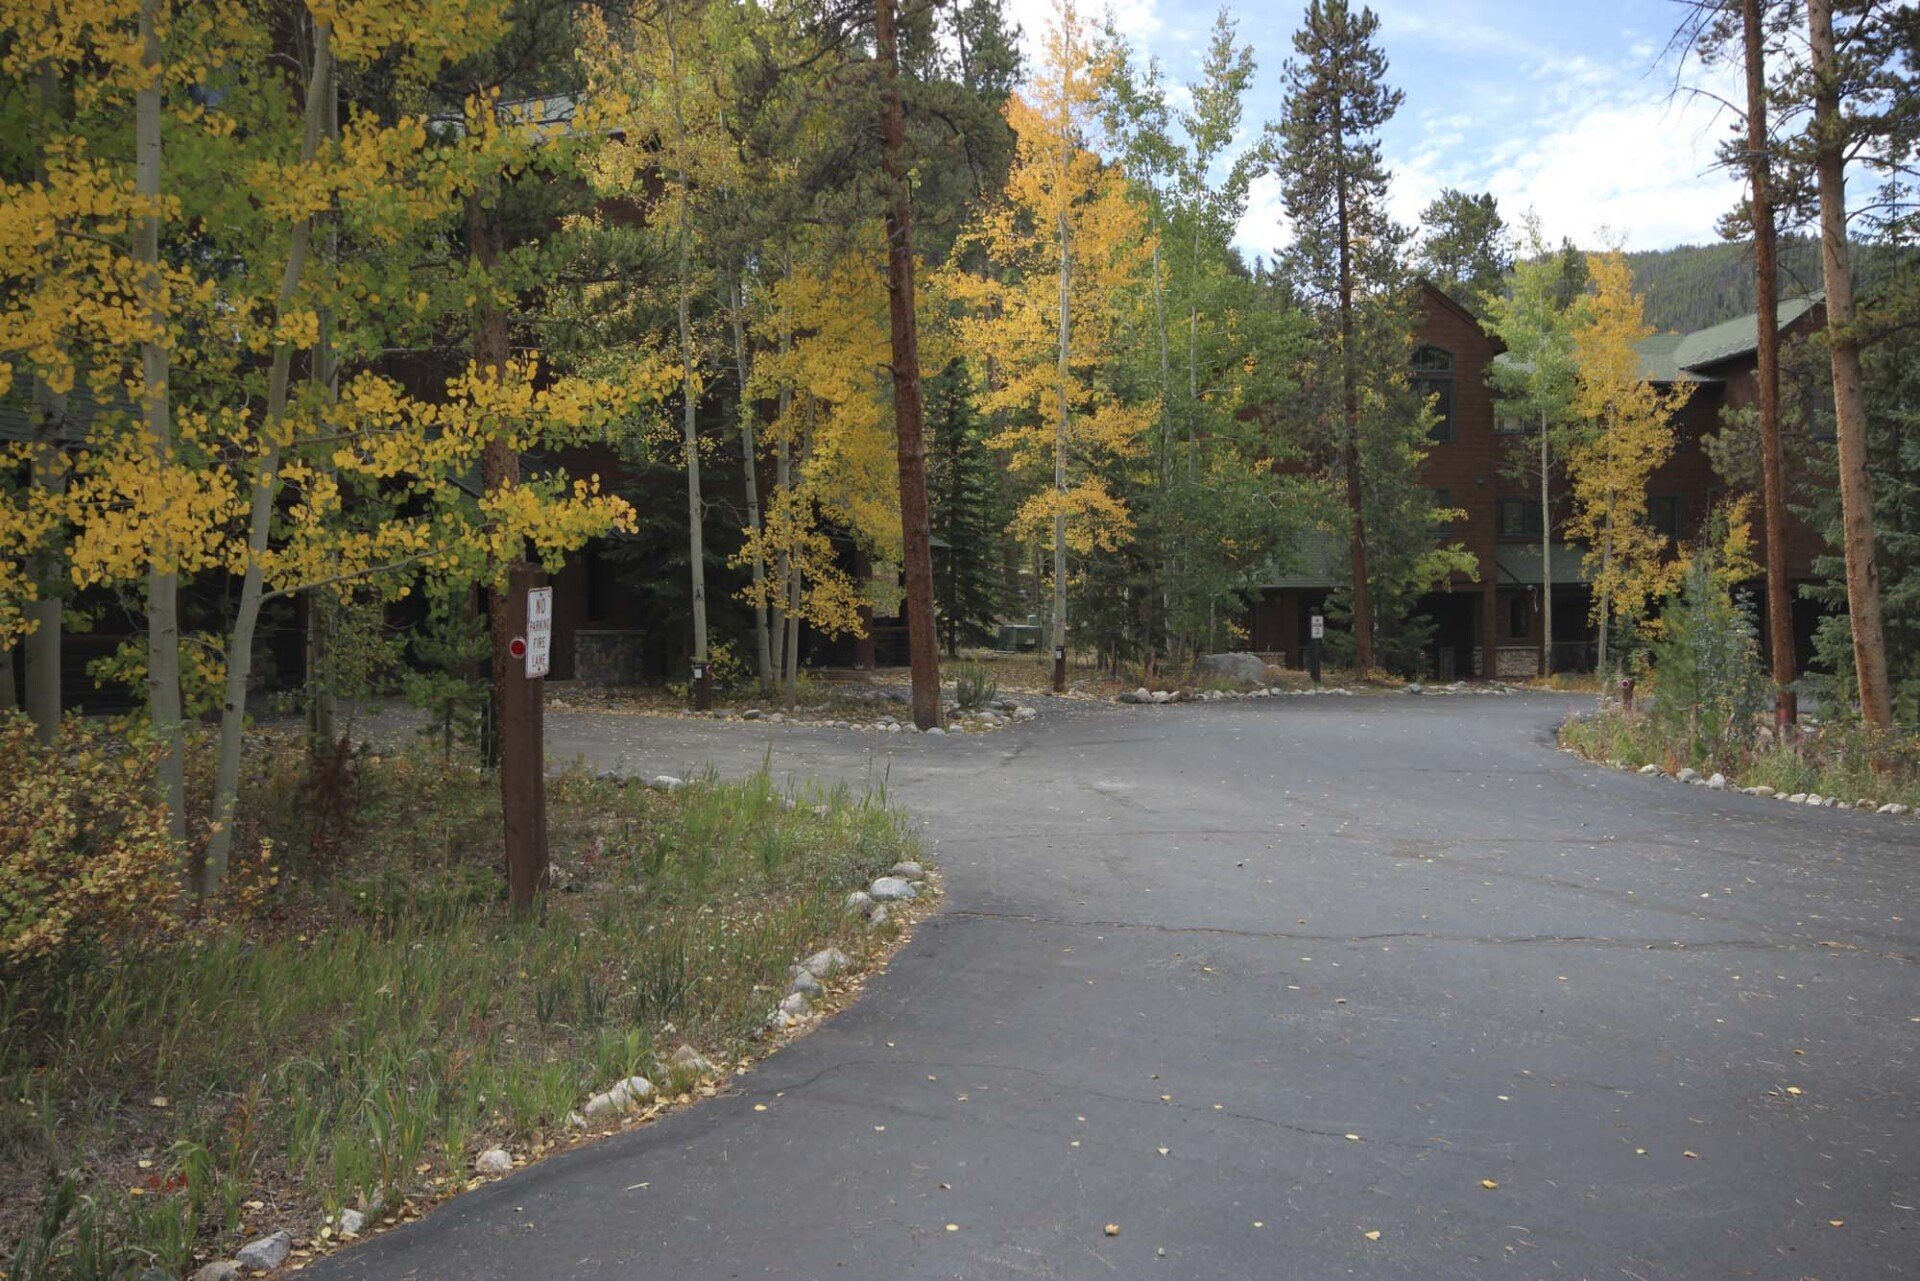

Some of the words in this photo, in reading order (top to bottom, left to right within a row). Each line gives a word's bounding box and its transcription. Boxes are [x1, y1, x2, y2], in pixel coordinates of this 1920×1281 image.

[535, 597, 546, 614] NO
[529, 618, 550, 631] PARKING
[533, 636, 546, 649] FIRE
[531, 653, 546, 667] LANE
